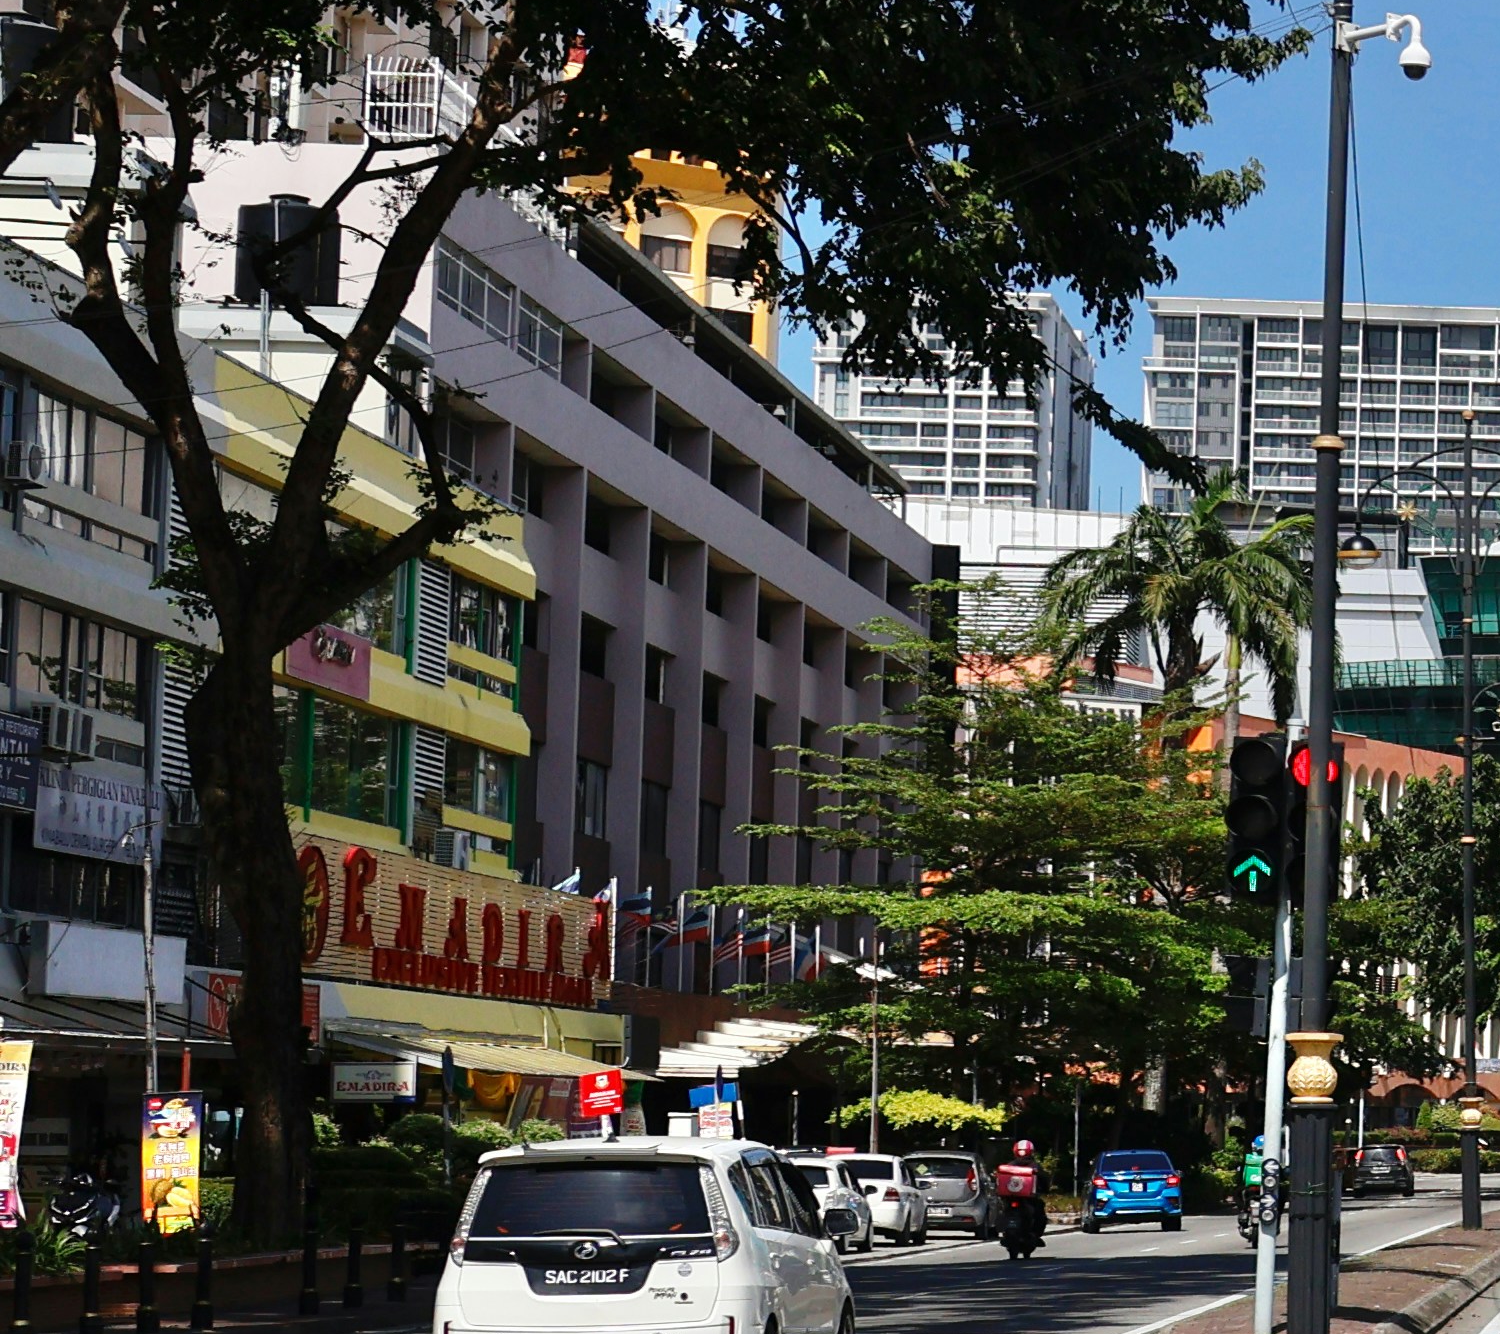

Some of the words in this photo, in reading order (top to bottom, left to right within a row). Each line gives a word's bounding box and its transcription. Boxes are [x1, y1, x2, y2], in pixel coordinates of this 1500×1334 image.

[72, 773, 118, 802] PERGIGIAN
[120, 783, 160, 810] KINABLU
[339, 845, 611, 981] EMADIRA
[336, 1080, 409, 1092] EMADIRA
[545, 1270, 577, 1284] SAC
[579, 1269, 617, 1284] 2102
[619, 1269, 630, 1283] F
